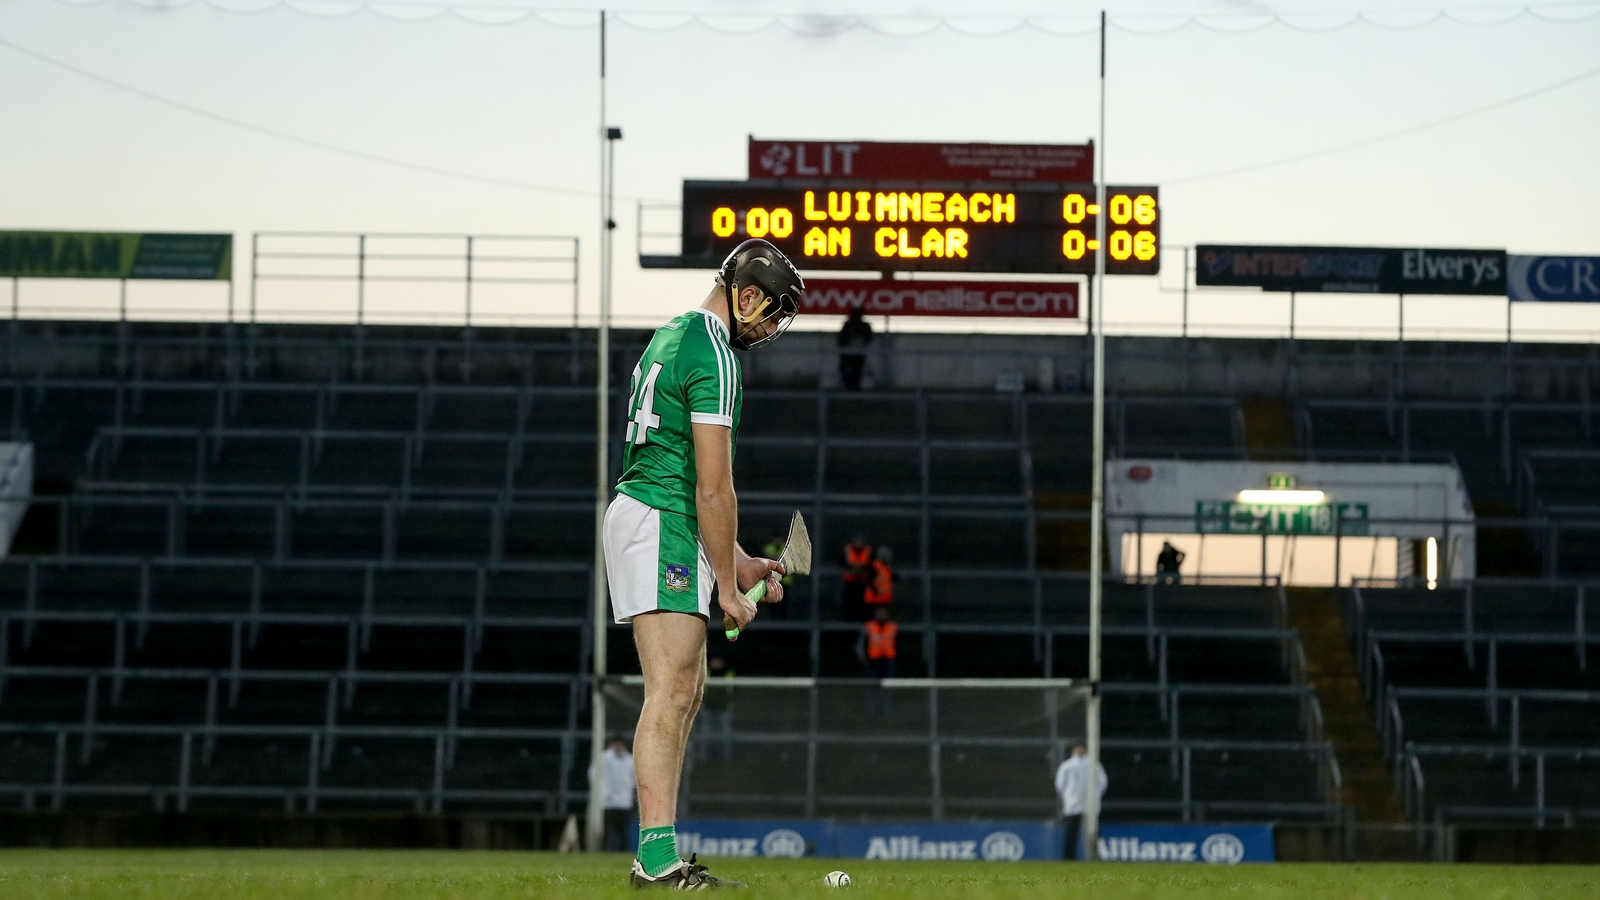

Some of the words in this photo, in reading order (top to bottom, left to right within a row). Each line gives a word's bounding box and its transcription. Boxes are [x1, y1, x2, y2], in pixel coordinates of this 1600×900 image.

[796, 144, 860, 175] LIT
[804, 191, 1016, 223] LUIMNEACH
[804, 226, 851, 257] AN
[874, 227, 969, 259] CLAR
[1401, 249, 1500, 286] Elverys
[1229, 503, 1301, 532] EXIT
[865, 836, 977, 860] Allianz
